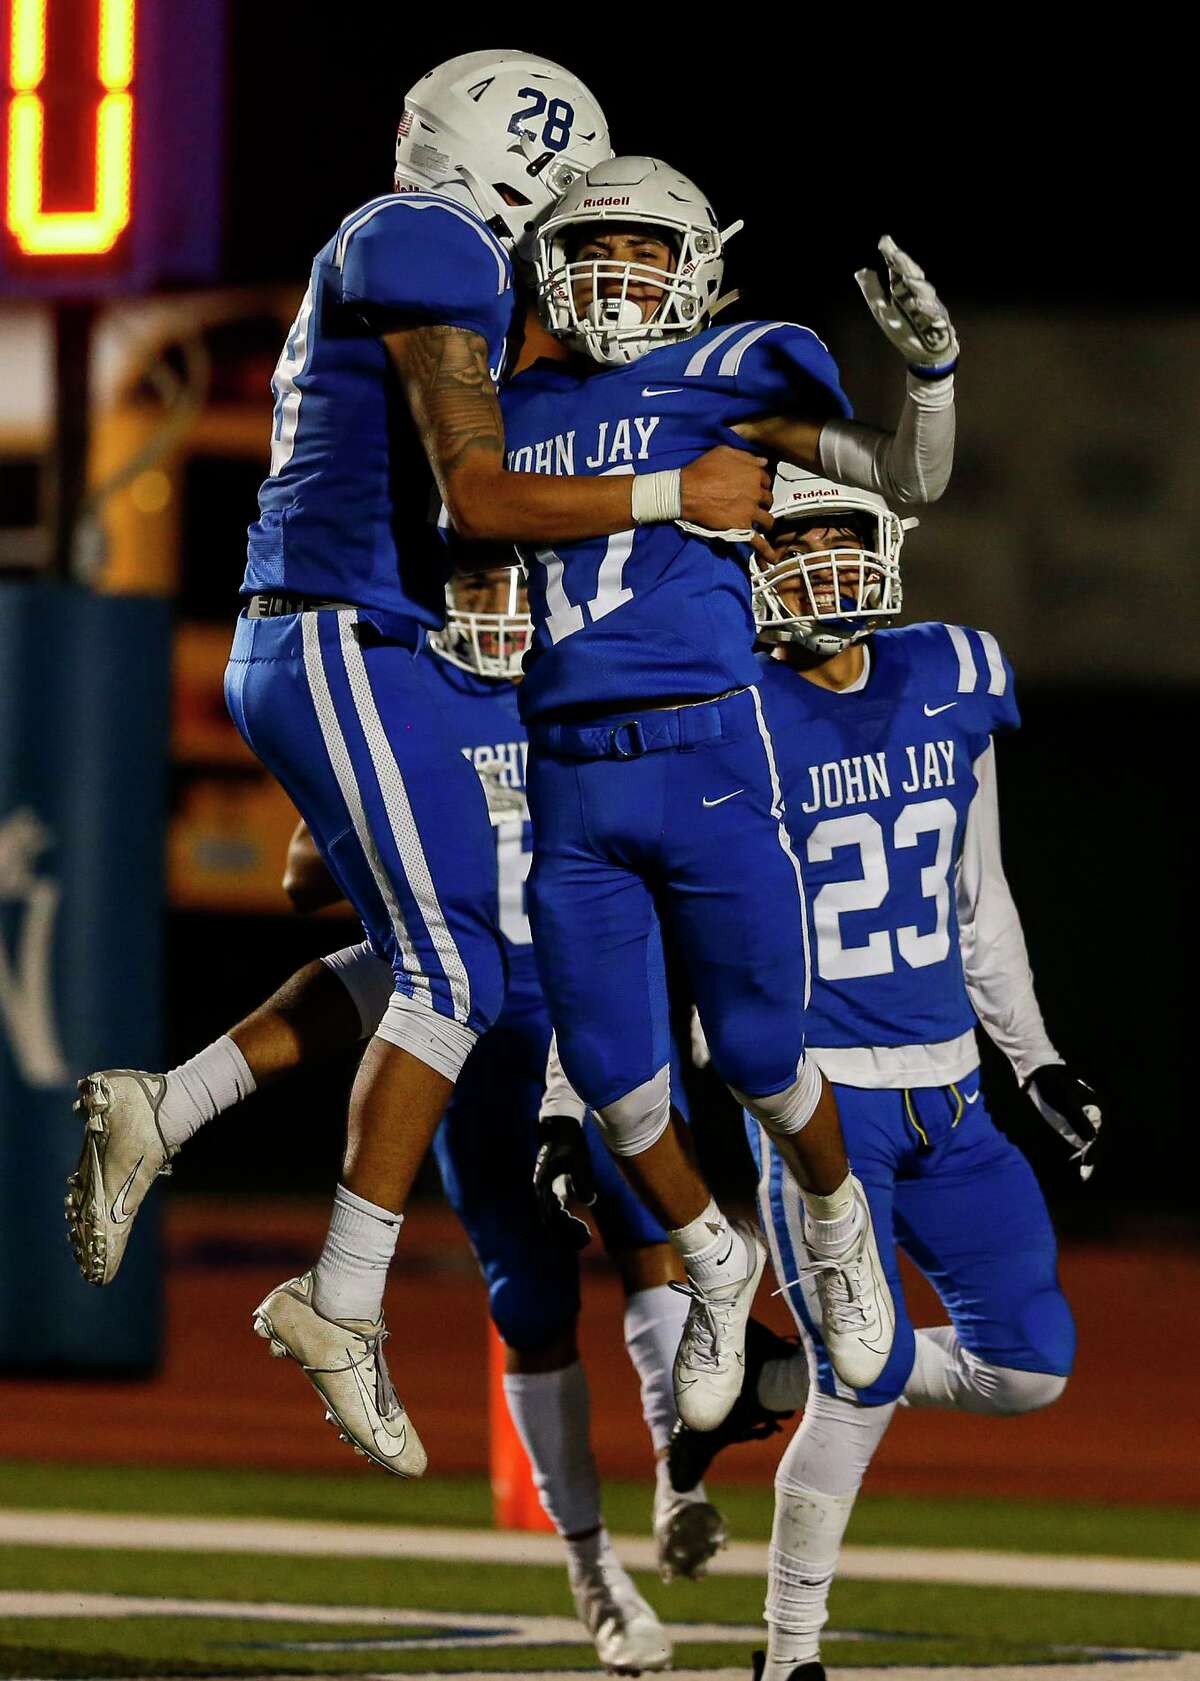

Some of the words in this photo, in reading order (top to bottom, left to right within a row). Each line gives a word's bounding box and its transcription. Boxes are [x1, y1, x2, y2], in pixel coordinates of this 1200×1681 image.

[507, 87, 575, 152] 28
[583, 196, 630, 208] Riddell
[586, 416, 660, 468] JAY
[792, 489, 840, 501] Riddell
[801, 752, 892, 814] JOHN
[902, 740, 957, 793] JAY
[806, 797, 958, 981] 23
